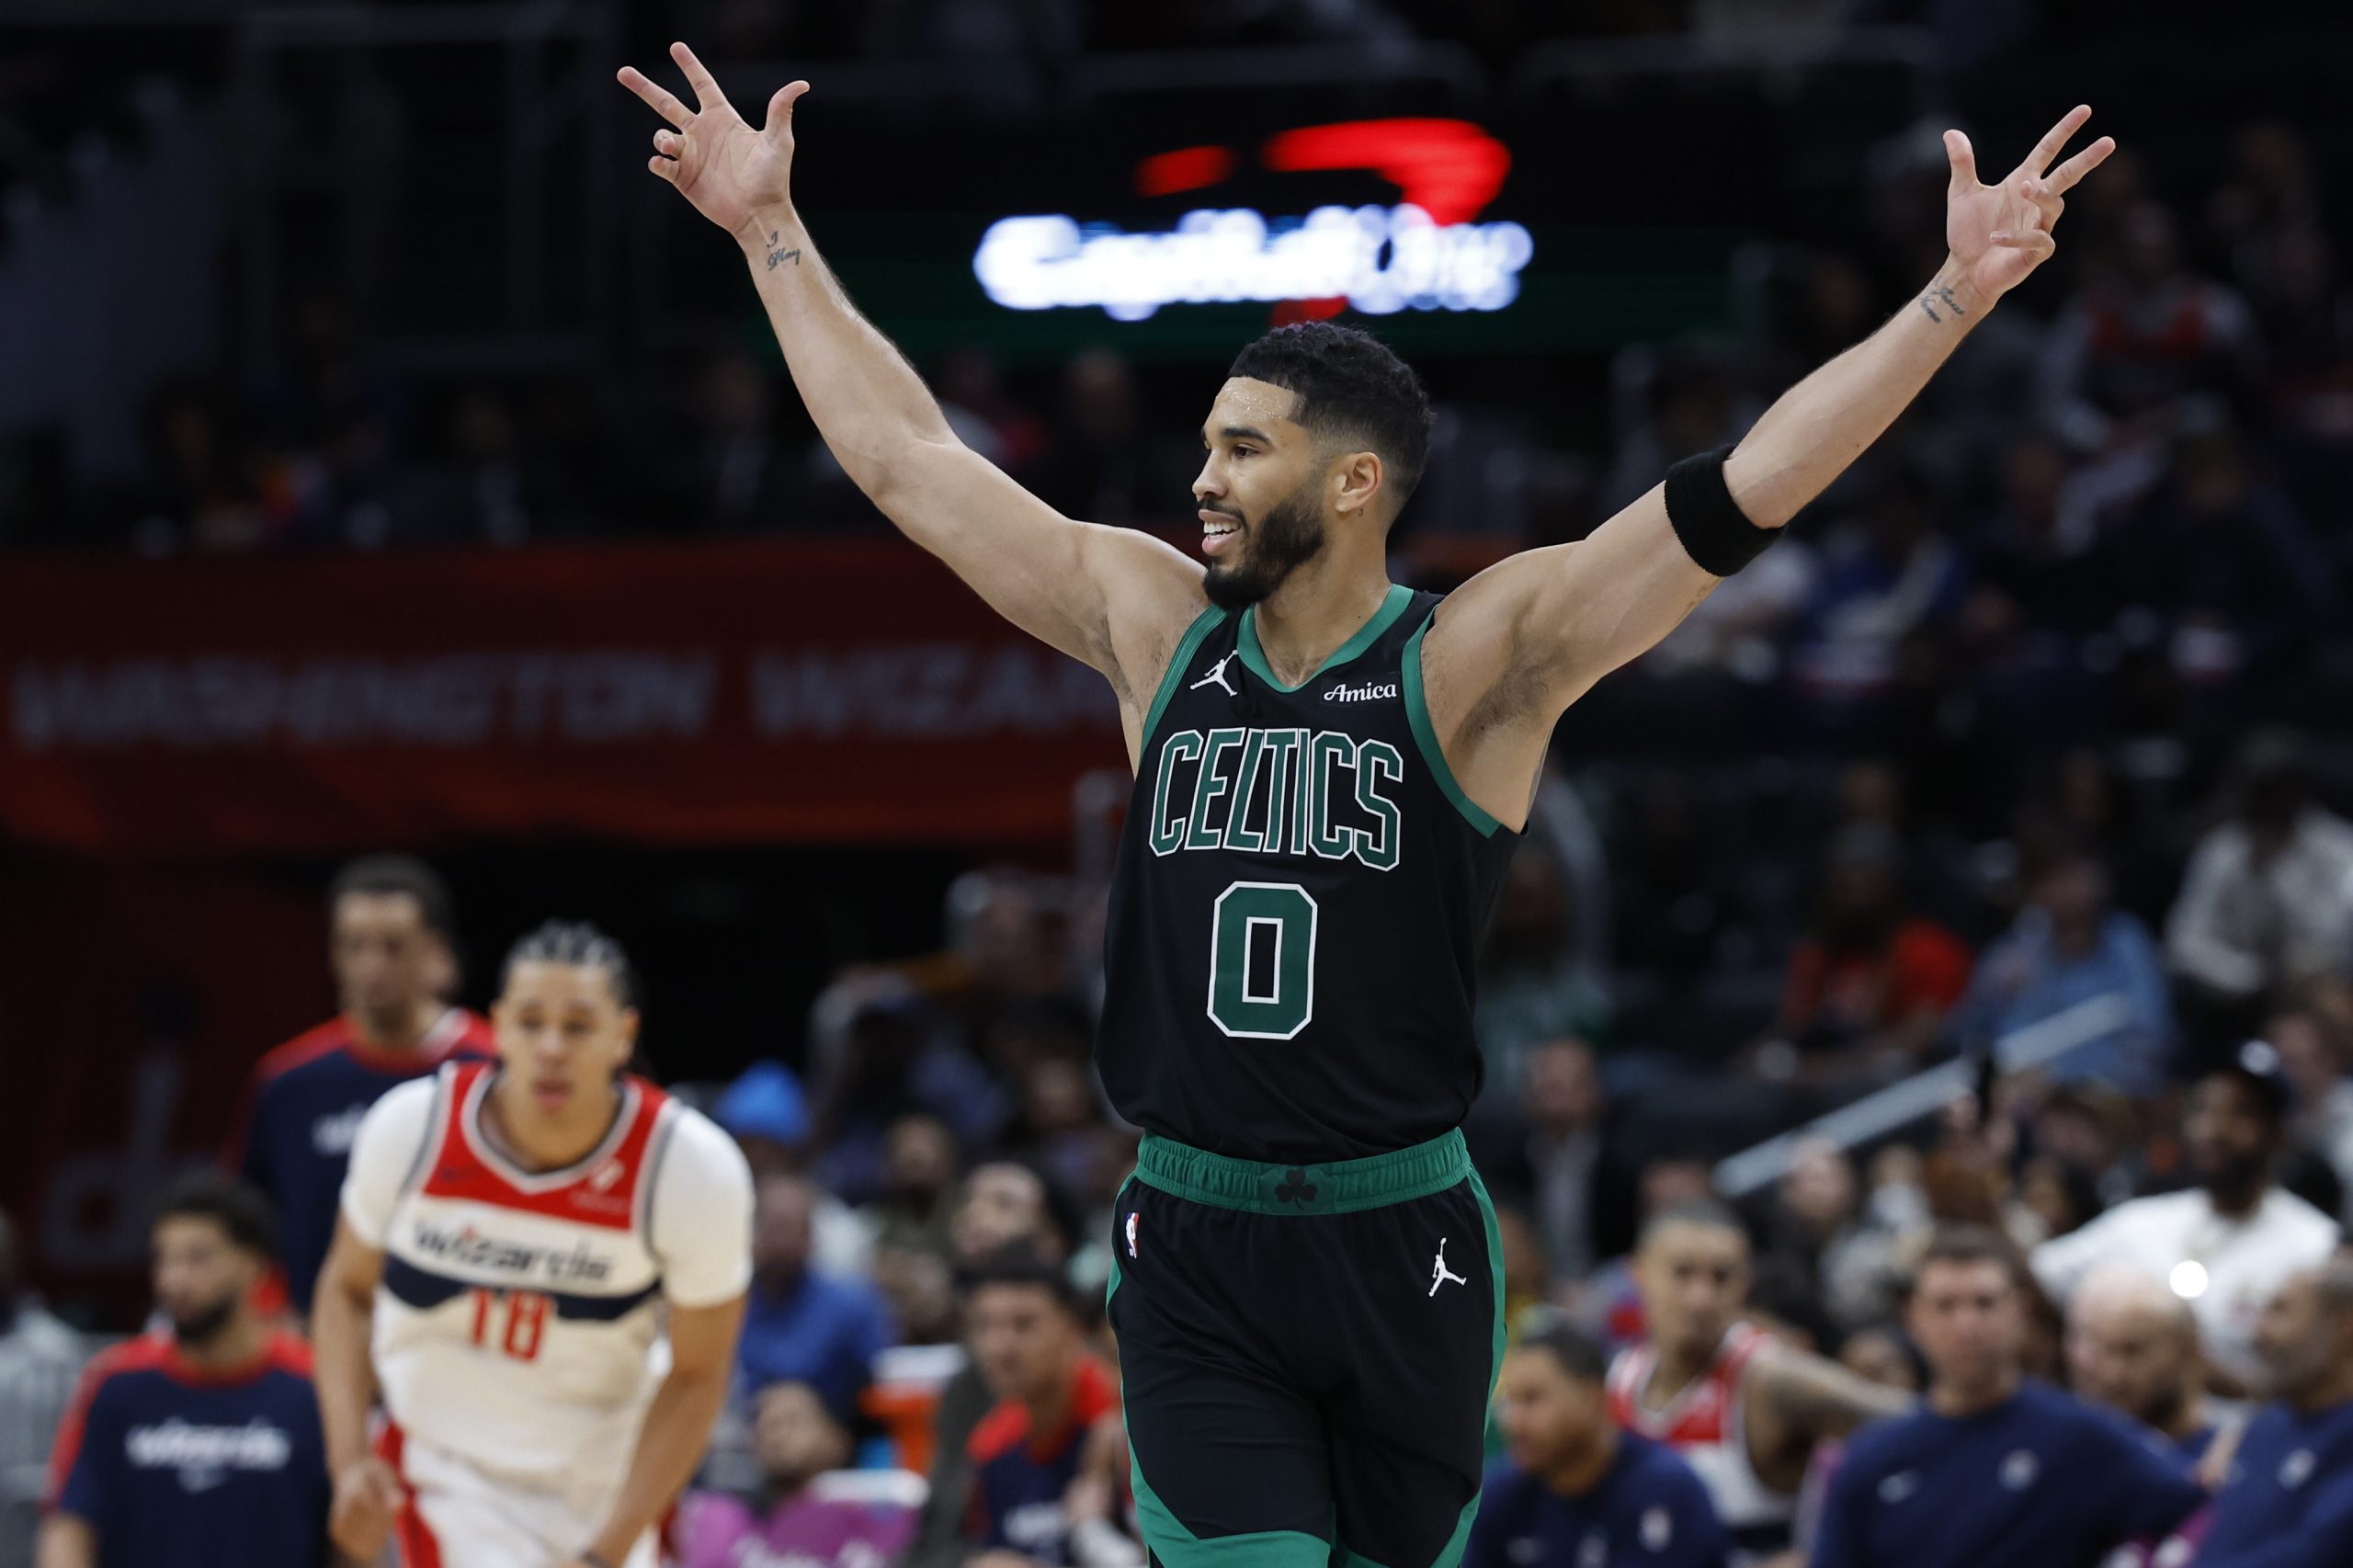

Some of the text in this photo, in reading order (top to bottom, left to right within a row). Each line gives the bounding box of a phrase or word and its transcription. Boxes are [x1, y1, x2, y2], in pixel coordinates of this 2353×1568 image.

[1324, 681, 1397, 702] Amica
[1149, 728, 1404, 871] CELTICS
[1207, 881, 1318, 1040] 0
[468, 1285, 554, 1361] 18
